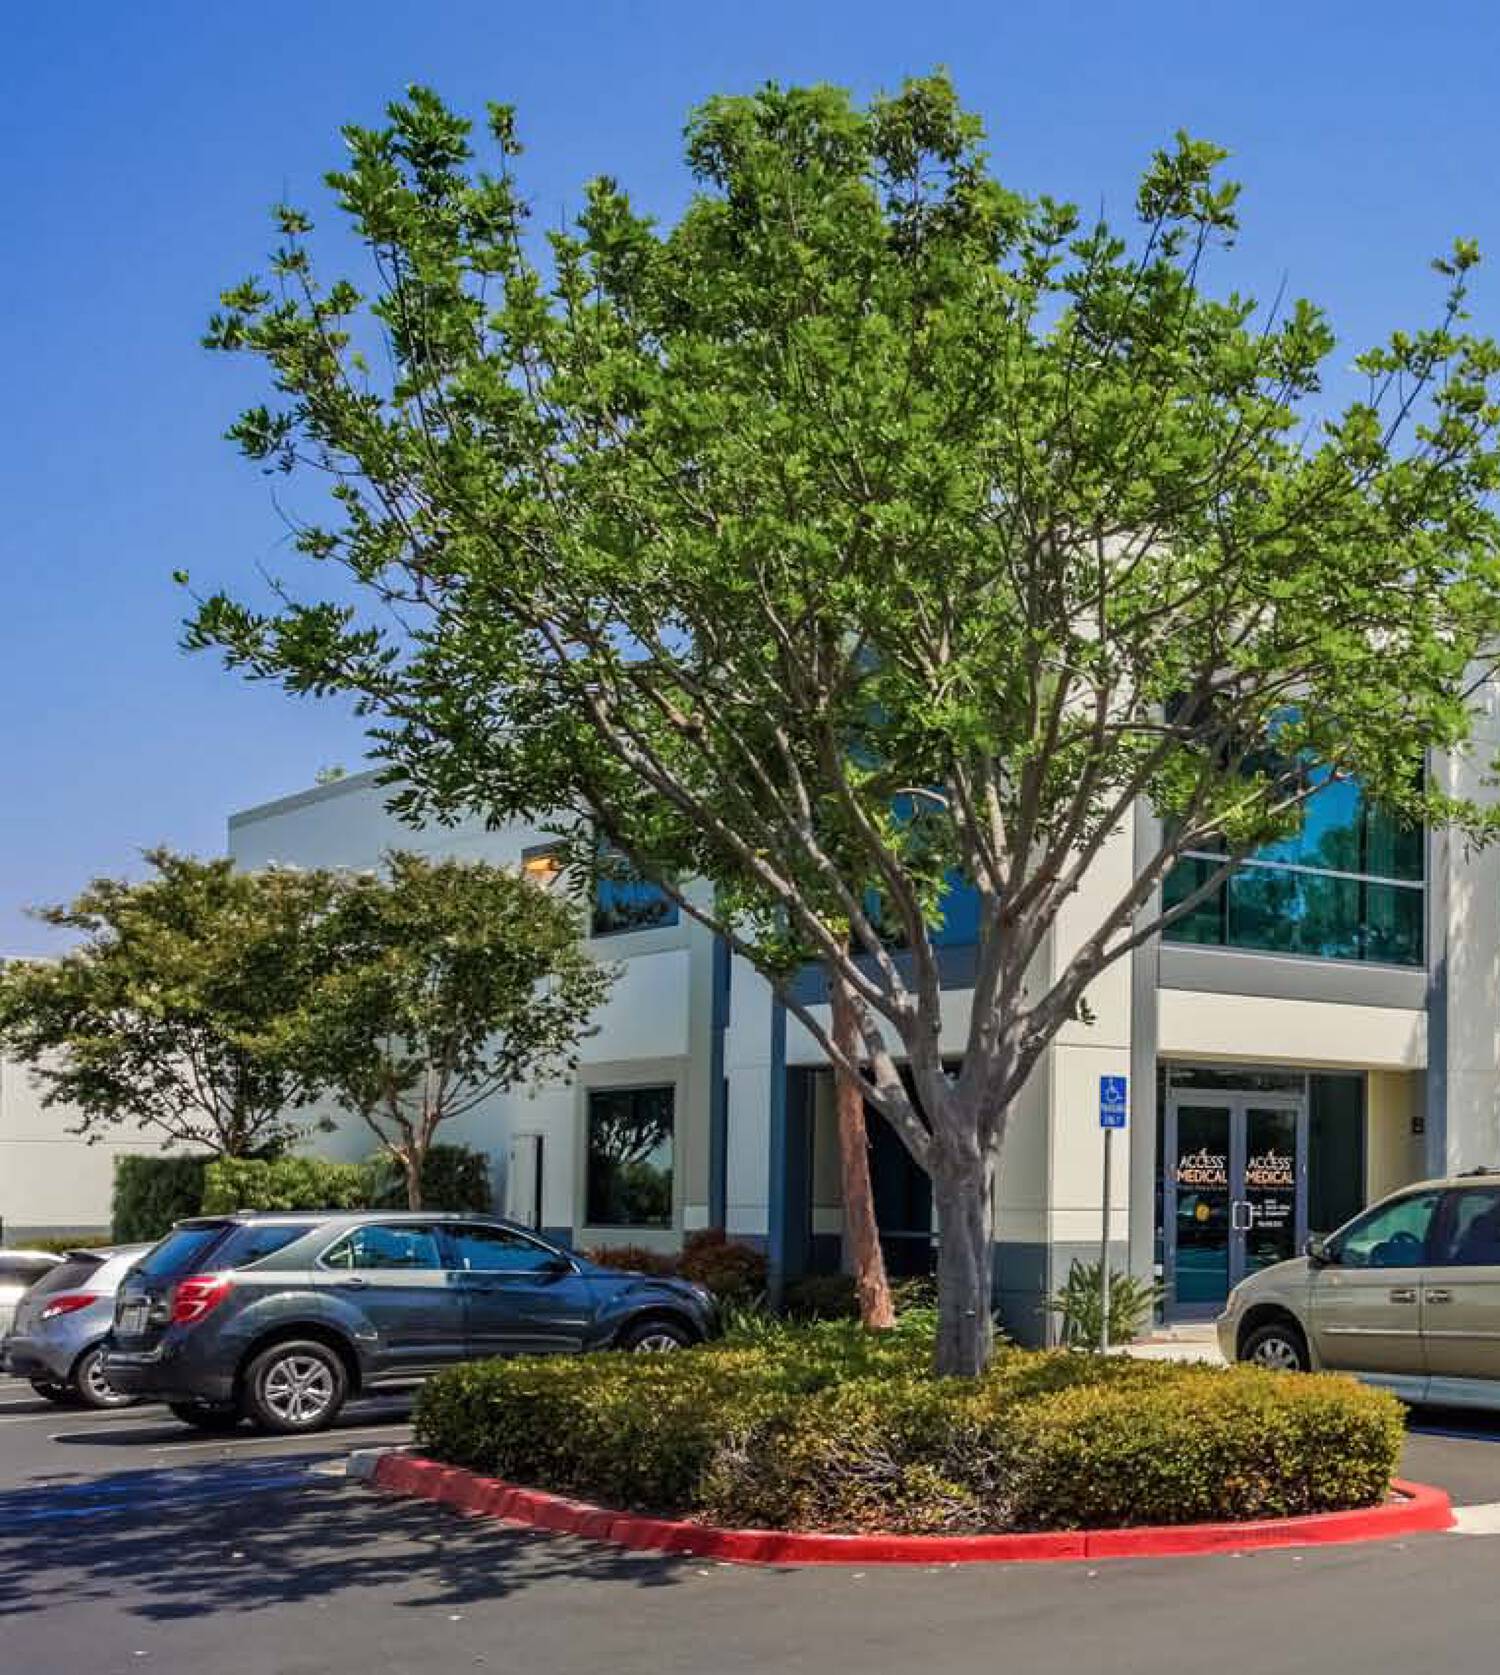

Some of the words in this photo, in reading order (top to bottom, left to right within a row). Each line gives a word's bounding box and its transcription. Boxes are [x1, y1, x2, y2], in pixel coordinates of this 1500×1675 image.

[1180, 1155, 1225, 1169] ACCESS
[1248, 1156, 1292, 1170] ACCESS
[1177, 1169, 1227, 1183] MEDICAL
[1245, 1170, 1294, 1184] MEDICAL
